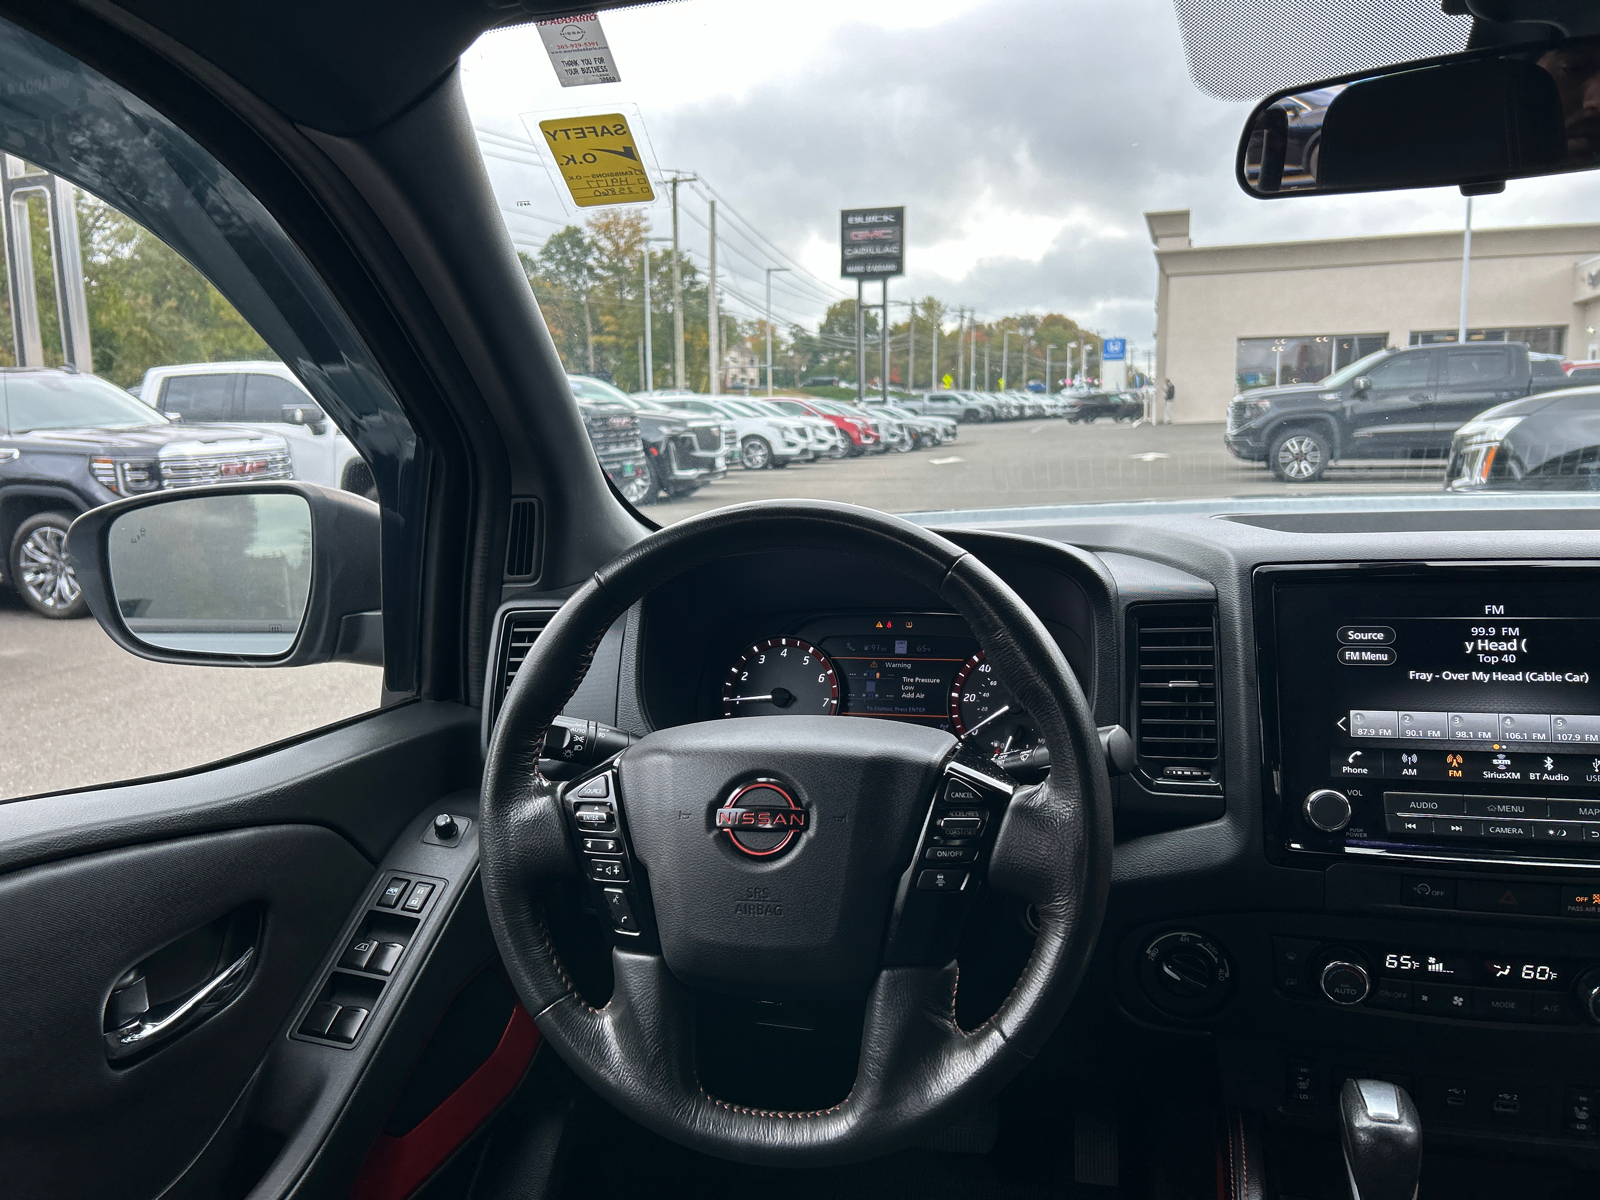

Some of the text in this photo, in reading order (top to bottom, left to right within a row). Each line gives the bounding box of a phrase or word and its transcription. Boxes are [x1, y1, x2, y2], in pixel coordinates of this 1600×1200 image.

[561, 57, 605, 68] THANK YOU FOR
[564, 65, 608, 76] YOUR BUSINESS
[847, 215, 896, 224] BUICK
[850, 229, 894, 241] GMC
[844, 245, 900, 255] CADILLAC
[1485, 604, 1505, 615] FM
[1347, 630, 1384, 640] Source
[1471, 627, 1520, 636] 99.9 FM
[1465, 641, 1474, 653] y
[1477, 639, 1518, 651] Head
[780, 648, 788, 657] 4
[1345, 651, 1388, 661] FM Menu
[758, 655, 766, 664] 3
[803, 655, 810, 665] 5
[1477, 653, 1516, 665] Top 40
[978, 664, 991, 673] 40
[741, 671, 749, 681] 2
[818, 673, 825, 683] 6
[1409, 670, 1433, 682] Fray
[1442, 671, 1470, 681] Over
[1472, 671, 1490, 682] My
[1492, 671, 1522, 681] Head
[1525, 671, 1562, 682] (Cable
[1564, 672, 1589, 683] Car)
[963, 693, 976, 702] 20
[822, 698, 830, 707] 7
[1357, 728, 1375, 736] 87.9
[1405, 729, 1423, 737] 90.1
[1455, 730, 1473, 738] 98.1
[1505, 732, 1528, 740] 106.1
[1557, 733, 1598, 742] 107.9 FM
[1342, 766, 1368, 774] Phone
[1402, 768, 1417, 776] AM
[1483, 771, 1521, 780] SiriusXM
[1529, 772, 1570, 781] BT Audio
[950, 791, 974, 799] CANCEL
[1347, 789, 1363, 797] VOL
[1409, 801, 1438, 809] AUDIO
[1497, 804, 1525, 813] MENU
[718, 811, 805, 826] NISSAN
[1489, 826, 1524, 834] CAMERA
[746, 887, 769, 899] SRS
[735, 903, 784, 917] AIRBAG
[1148, 947, 1159, 961] 2WD
[1334, 987, 1357, 995] AUTO
[1491, 1001, 1516, 1009] MODE
[1543, 1004, 1560, 1012] A/C
